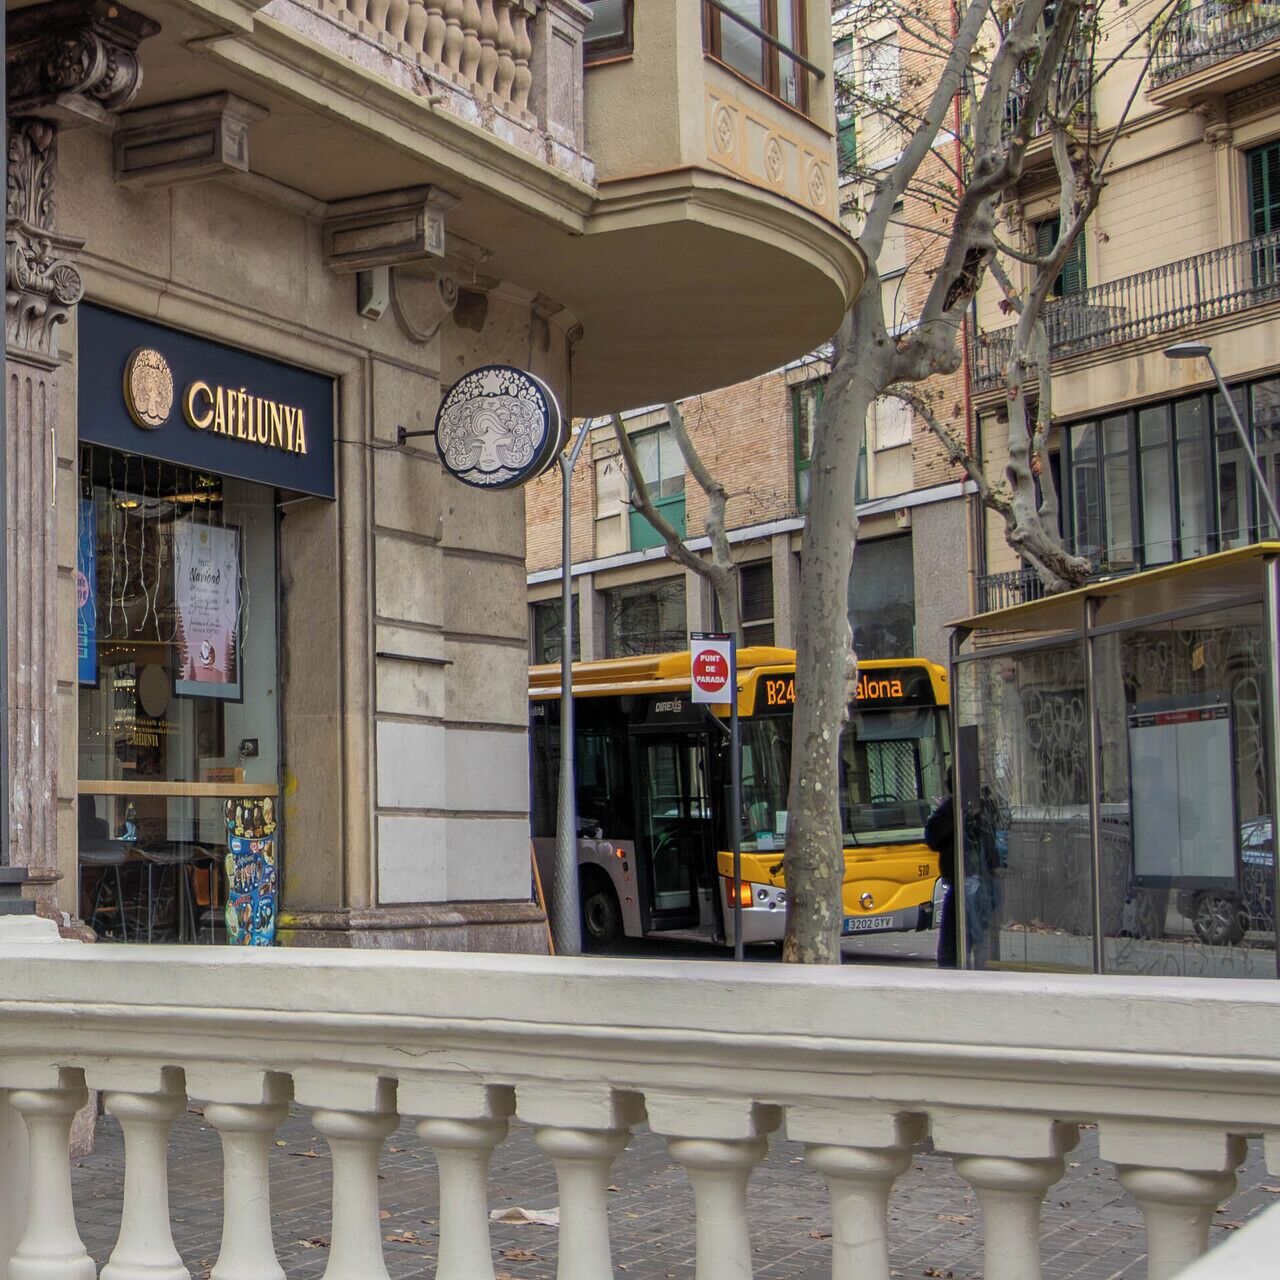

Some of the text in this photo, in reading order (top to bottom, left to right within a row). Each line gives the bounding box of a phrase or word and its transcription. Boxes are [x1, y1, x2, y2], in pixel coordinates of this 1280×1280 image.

[186, 380, 308, 455] CAFÉLUNYA
[705, 665, 716, 673] DE
[850, 919, 873, 930] 3202
